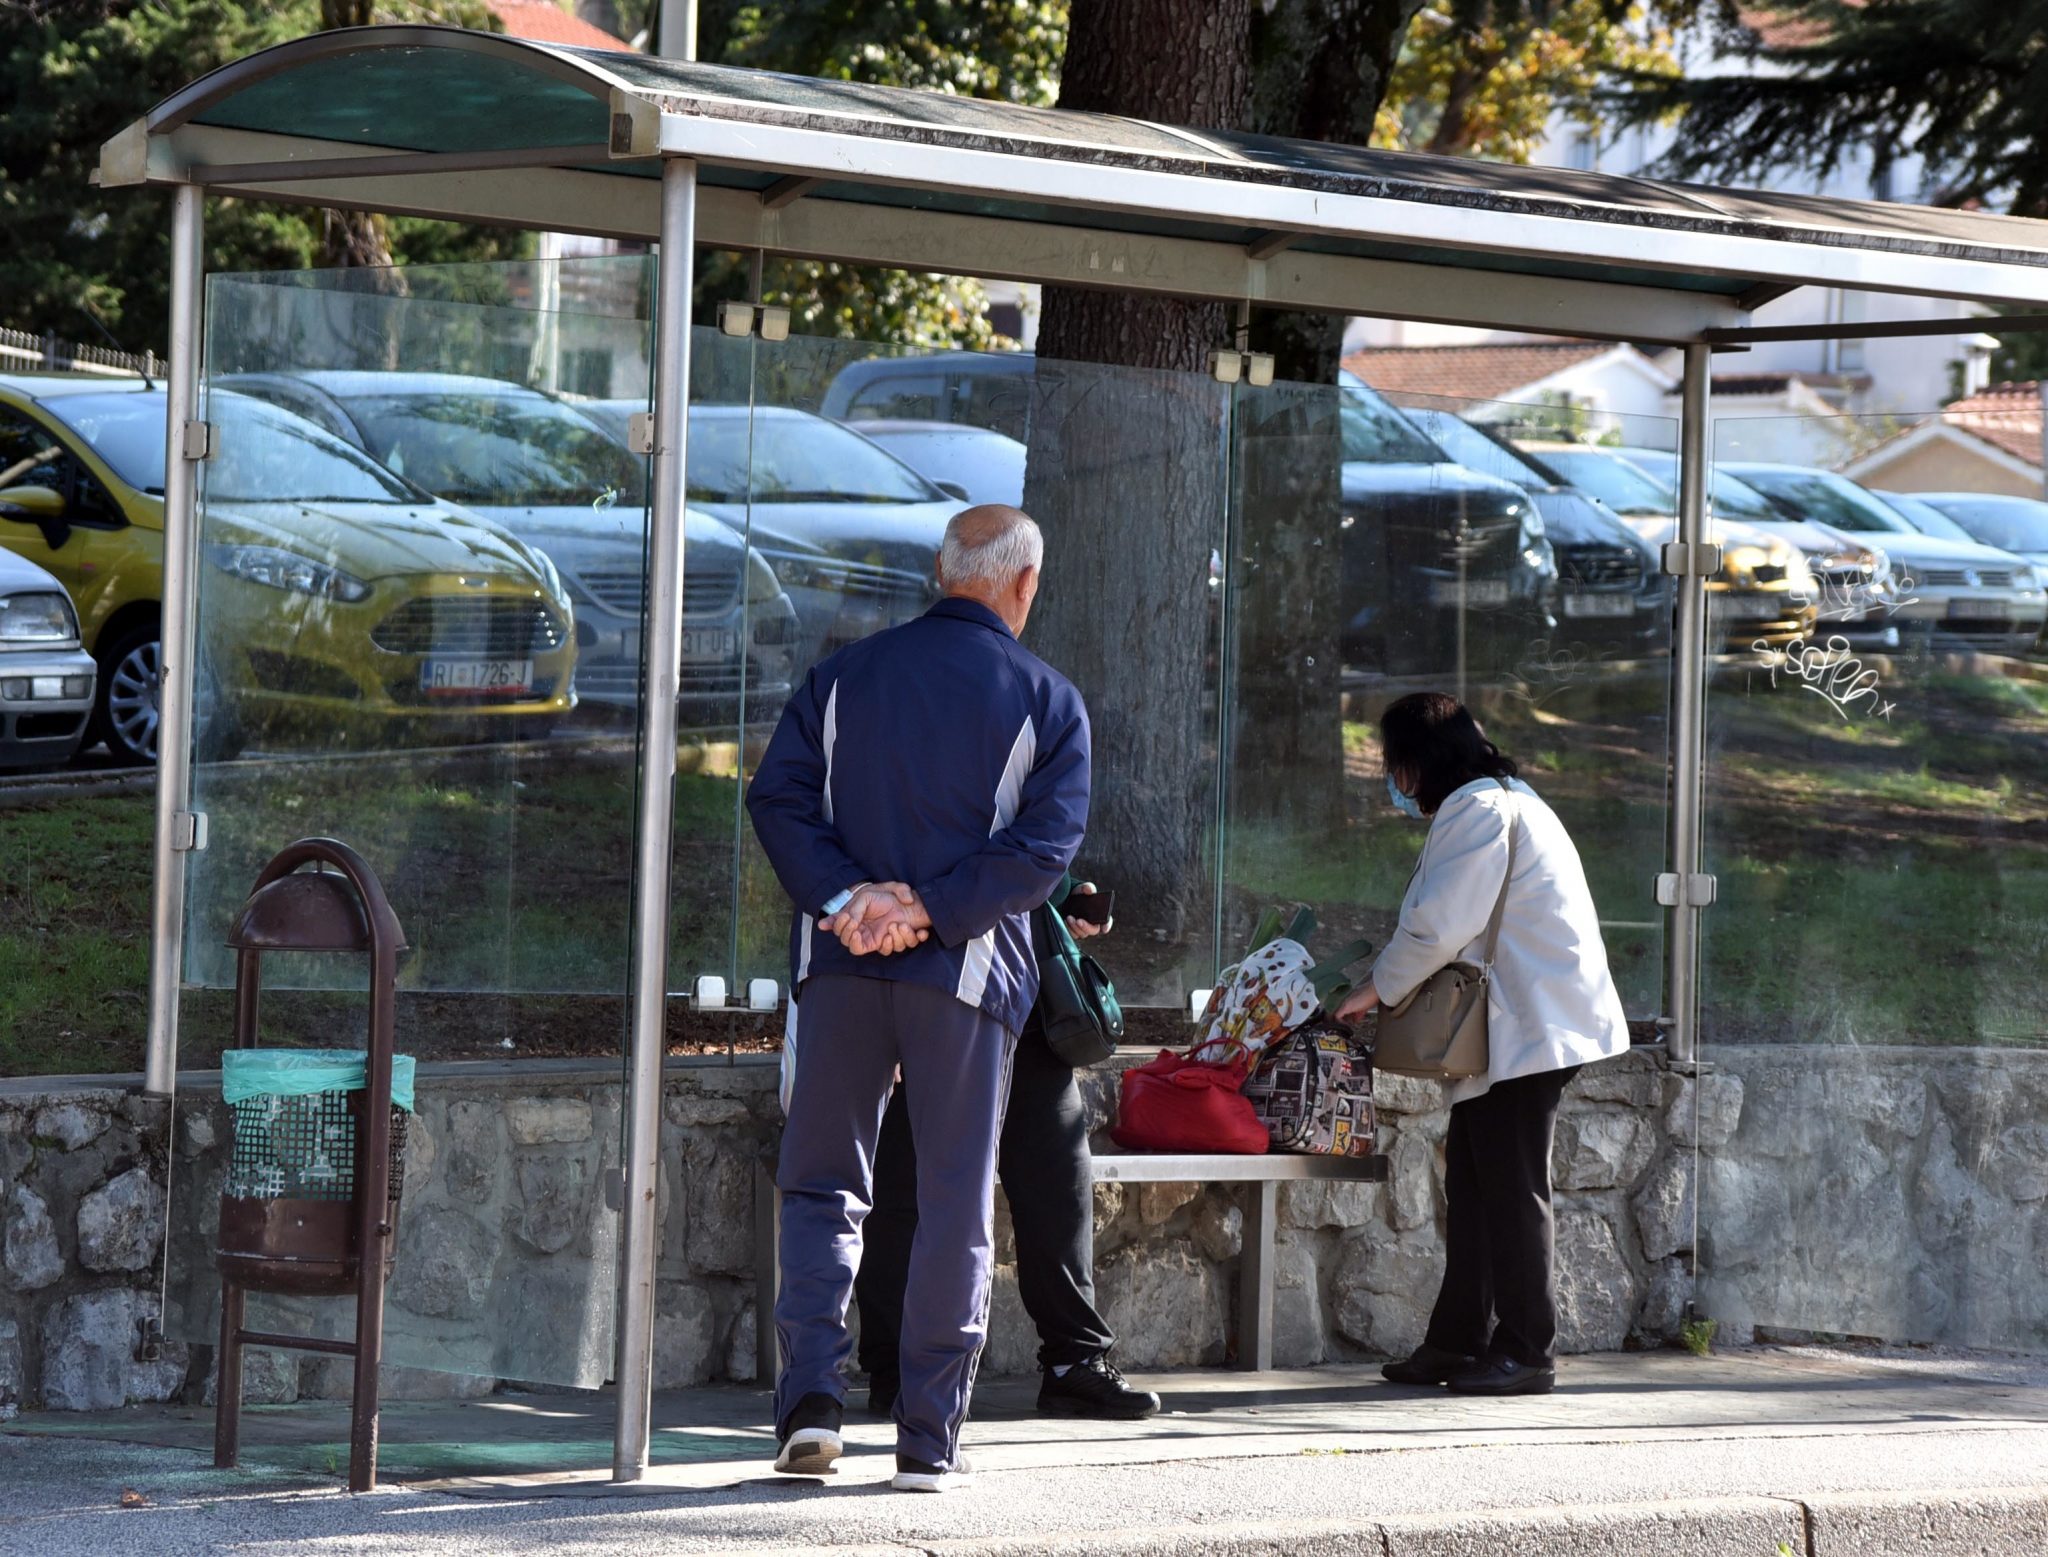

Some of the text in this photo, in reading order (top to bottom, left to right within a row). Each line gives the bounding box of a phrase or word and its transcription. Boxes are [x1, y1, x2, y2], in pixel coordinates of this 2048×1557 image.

[682, 631, 732, 654] 31-UE
[434, 662, 528, 687] RI 1726-J
